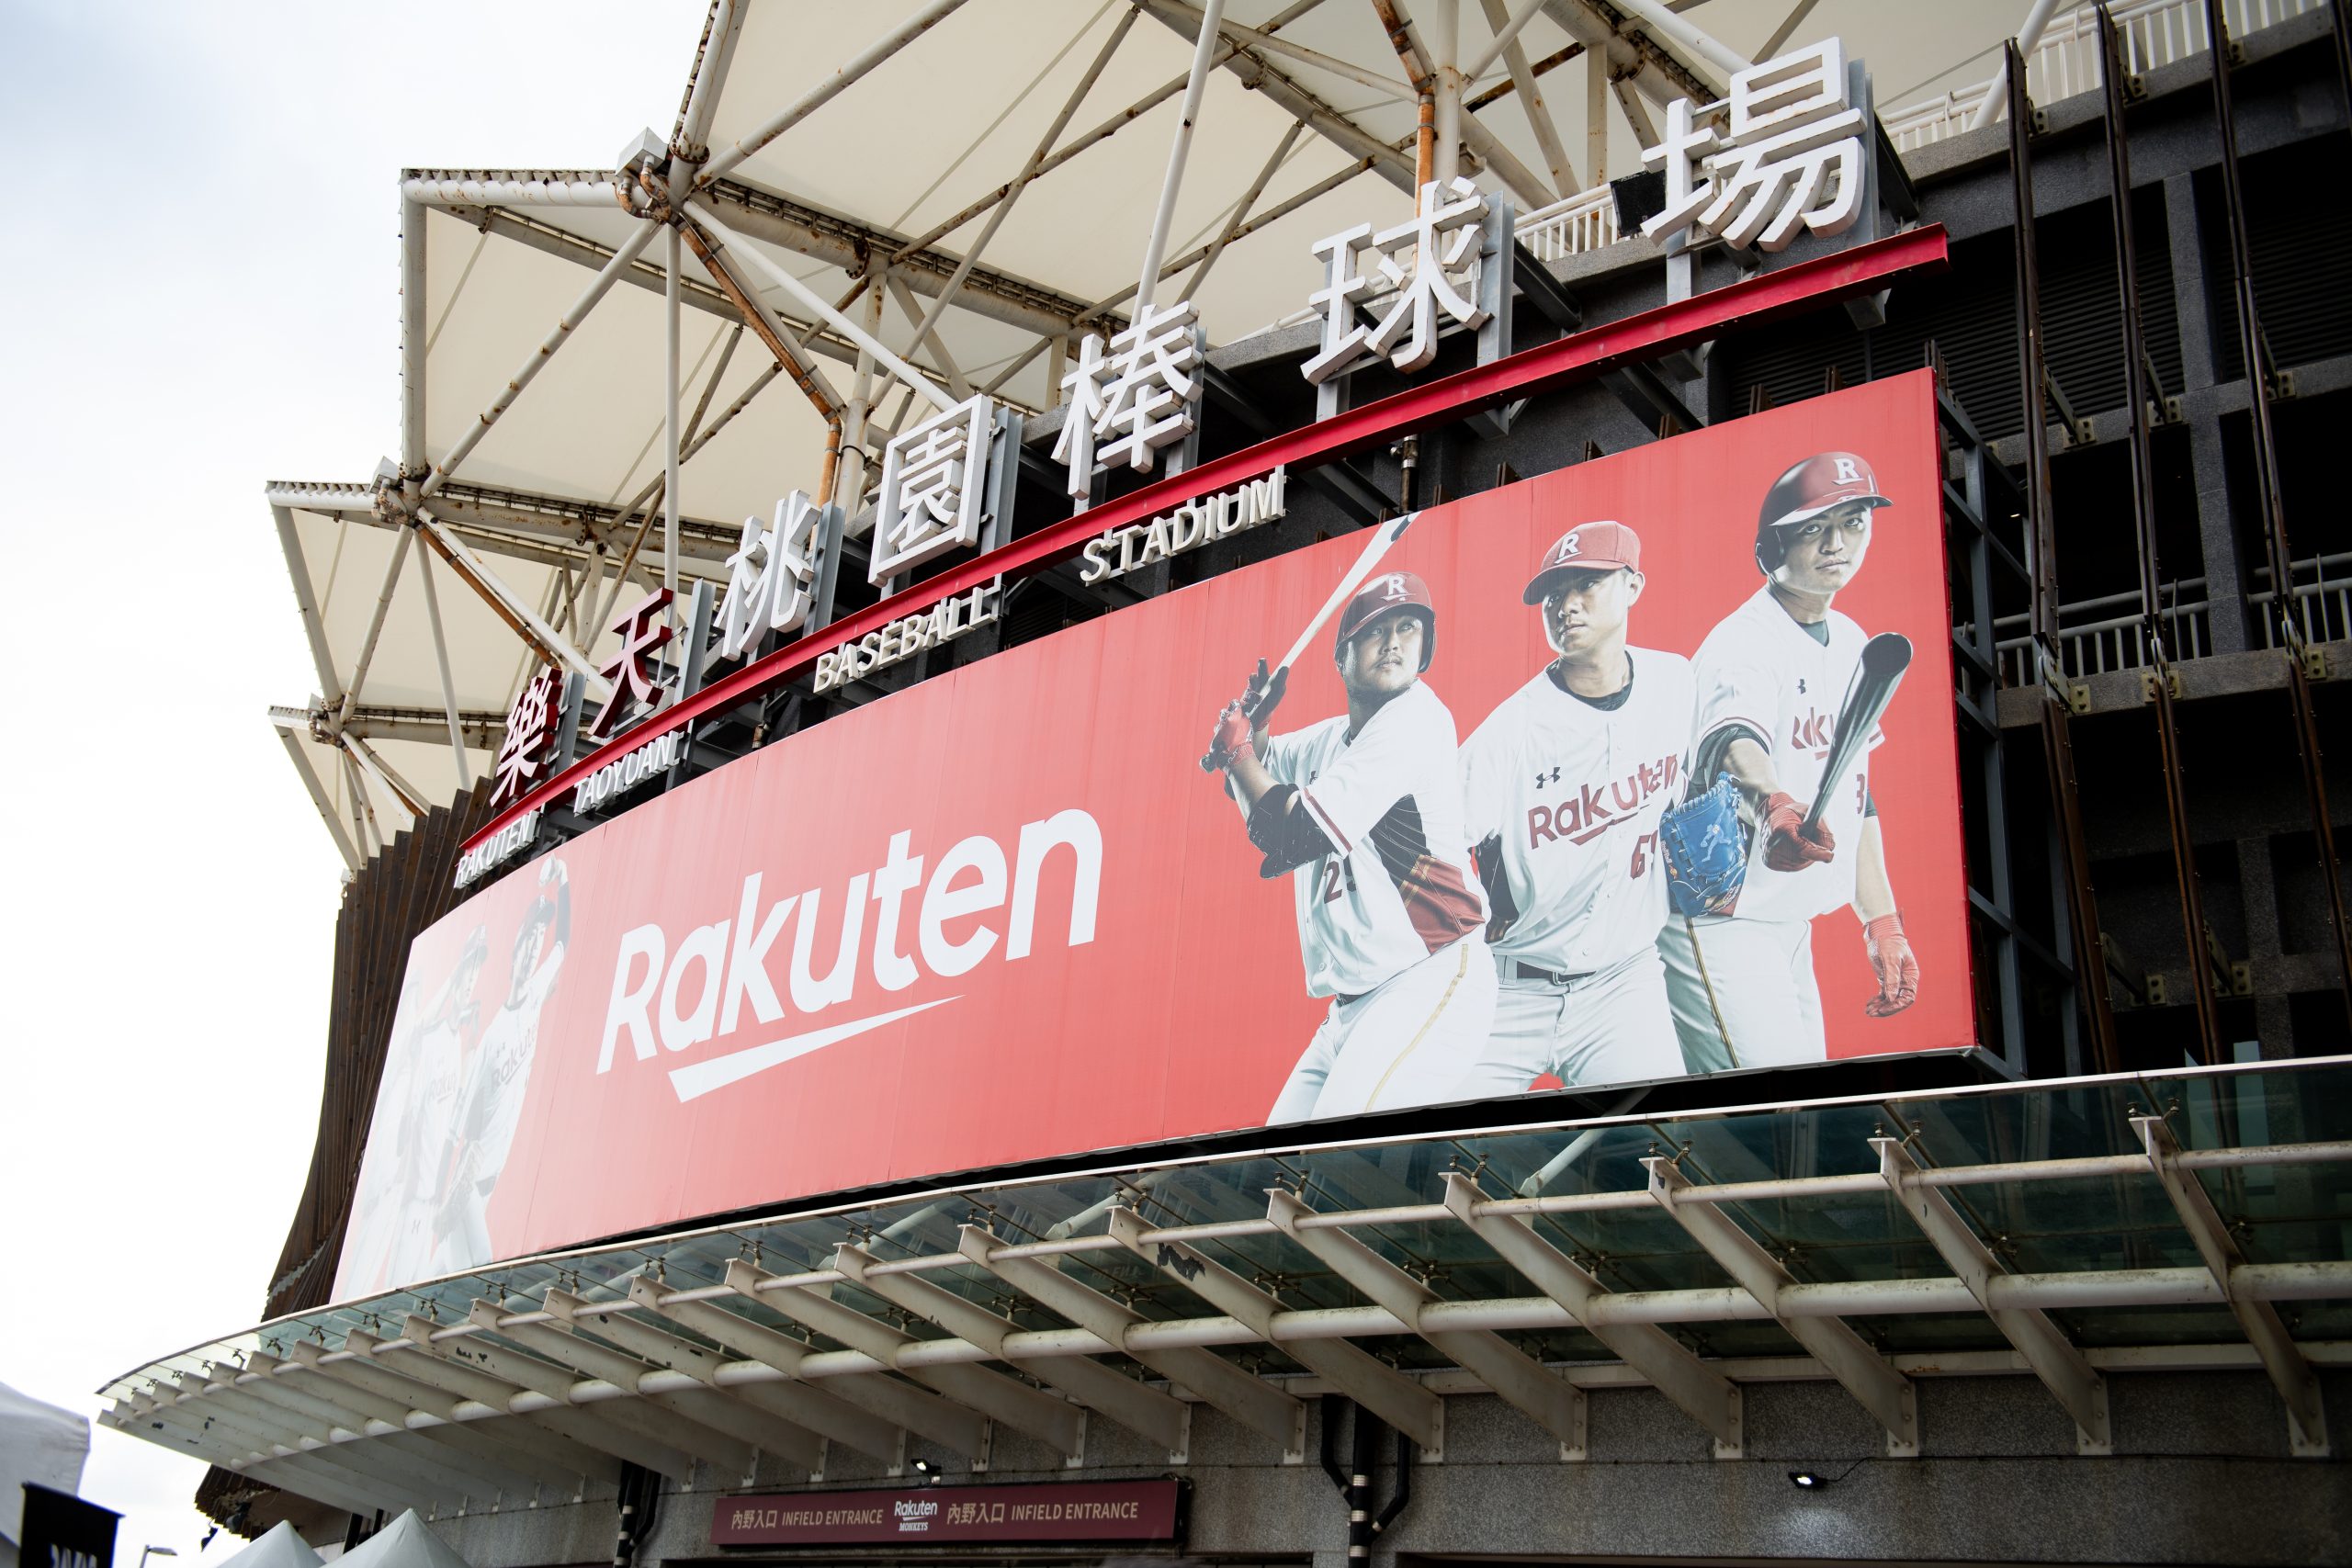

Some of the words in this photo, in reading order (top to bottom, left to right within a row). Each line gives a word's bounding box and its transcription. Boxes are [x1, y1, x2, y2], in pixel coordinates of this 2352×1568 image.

[490, 37, 1868, 809] 樂天桃園棒球場
[1834, 458, 1860, 479] R
[1559, 534, 1579, 558] R
[1388, 576, 1408, 596] R
[454, 810, 540, 888] RAKUTEN
[574, 730, 680, 817] TAOYUAN
[813, 586, 999, 694] BASEBALL
[1080, 468, 1286, 586] STADIUM
[596, 809, 1102, 1075] Rakuten
[782, 1511, 823, 1526] INFIELD
[826, 1508, 884, 1525] ENTRANCE
[894, 1499, 938, 1517] Rakuten
[1012, 1504, 1062, 1520] INFIELD
[1066, 1502, 1139, 1519] ENTRANCE
[899, 1521, 929, 1532] MONKEYS
